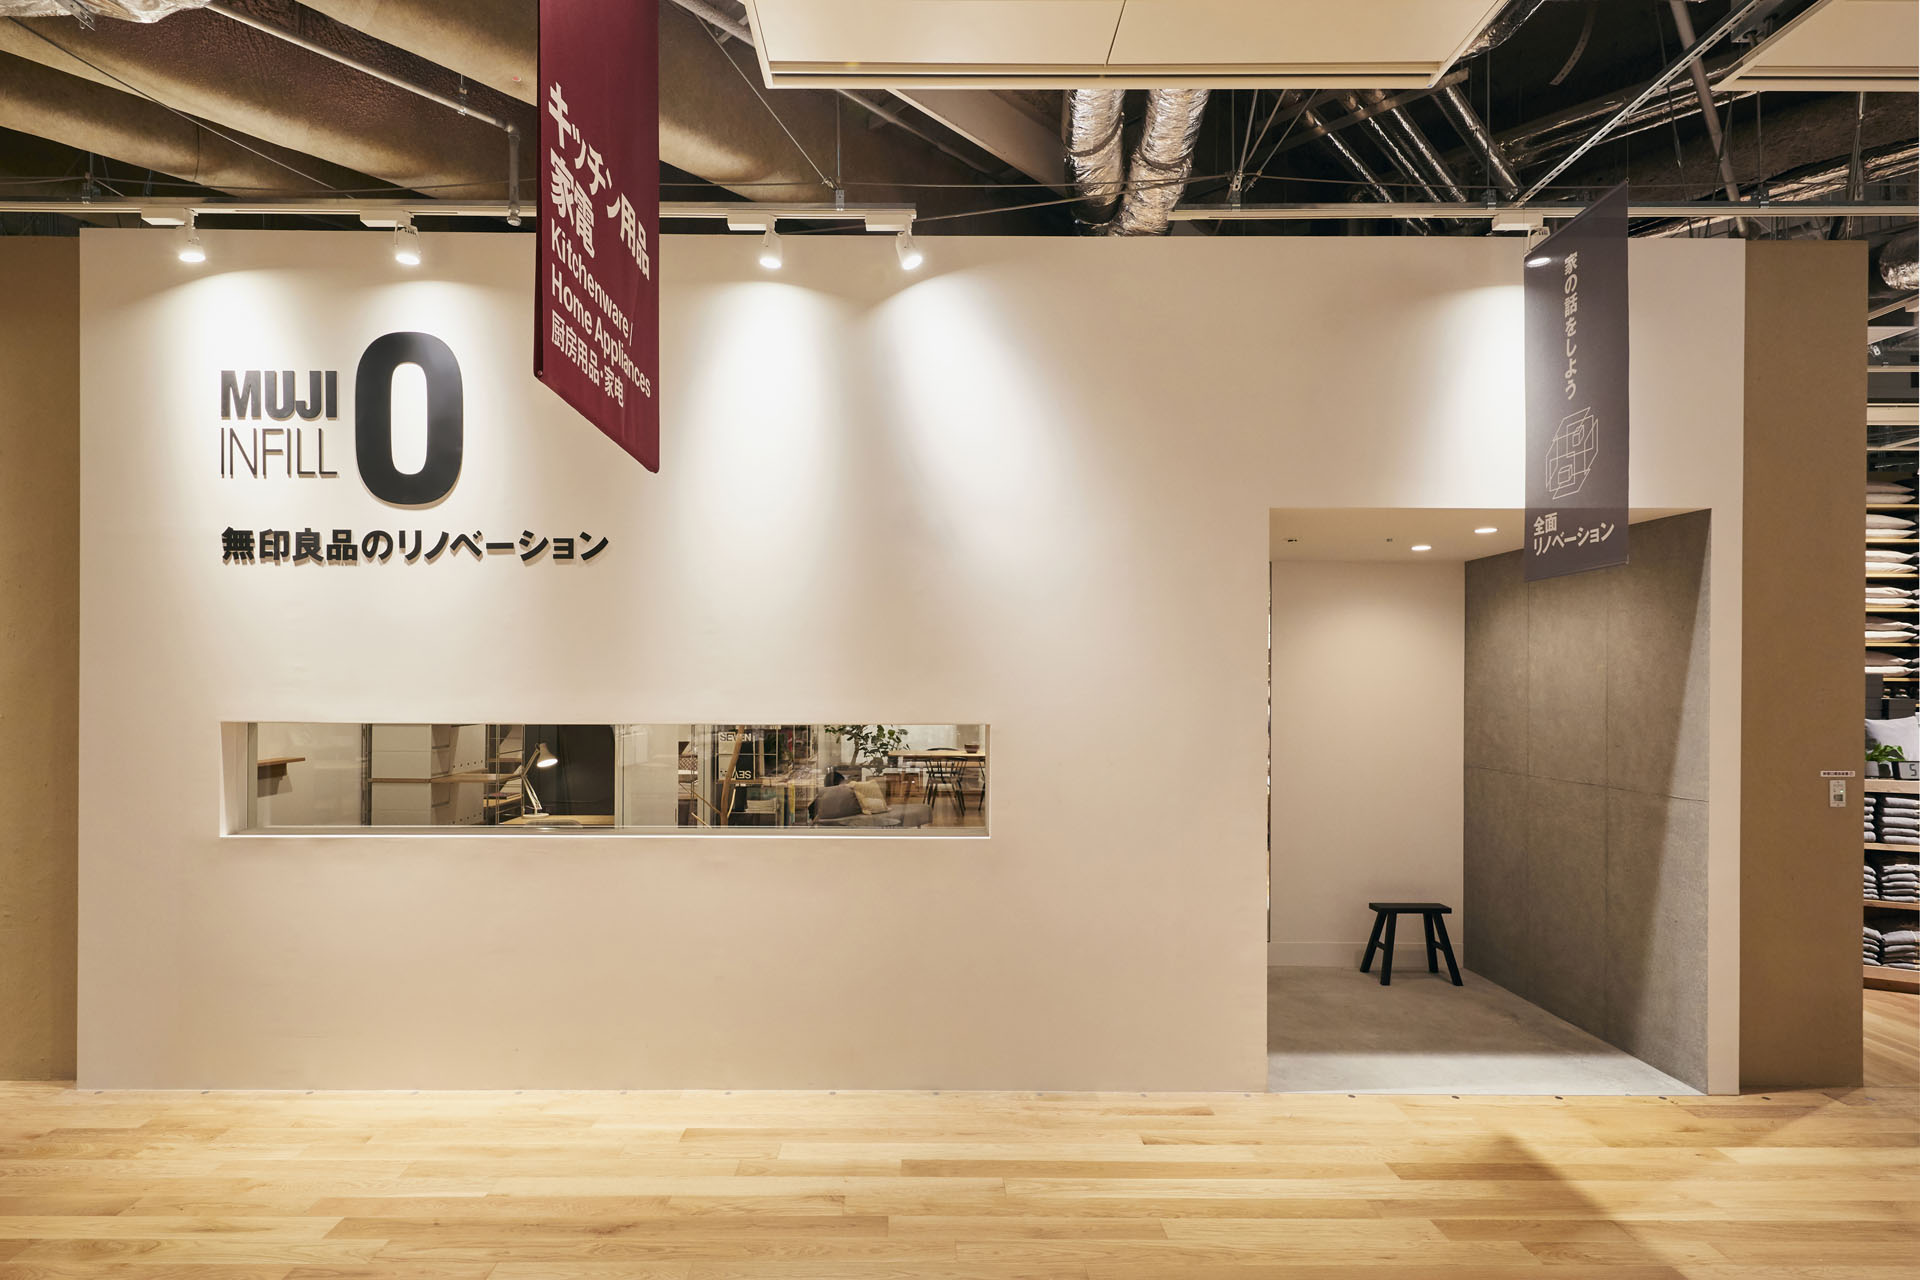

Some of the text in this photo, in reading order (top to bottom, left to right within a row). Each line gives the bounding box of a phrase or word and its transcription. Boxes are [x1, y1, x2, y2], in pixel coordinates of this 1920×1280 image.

[548, 81, 650, 281] キッチン用品
[551, 147, 596, 259] 家電
[551, 262, 651, 399] Home Appliances
[1563, 251, 1578, 401] 家の話をしよう
[220, 370, 338, 420] MUJI
[220, 427, 338, 479] INFILL
[220, 525, 610, 564] 無印良品のリノベーション
[1533, 511, 1558, 537] 全面
[1533, 522, 1615, 556] リノベーション
